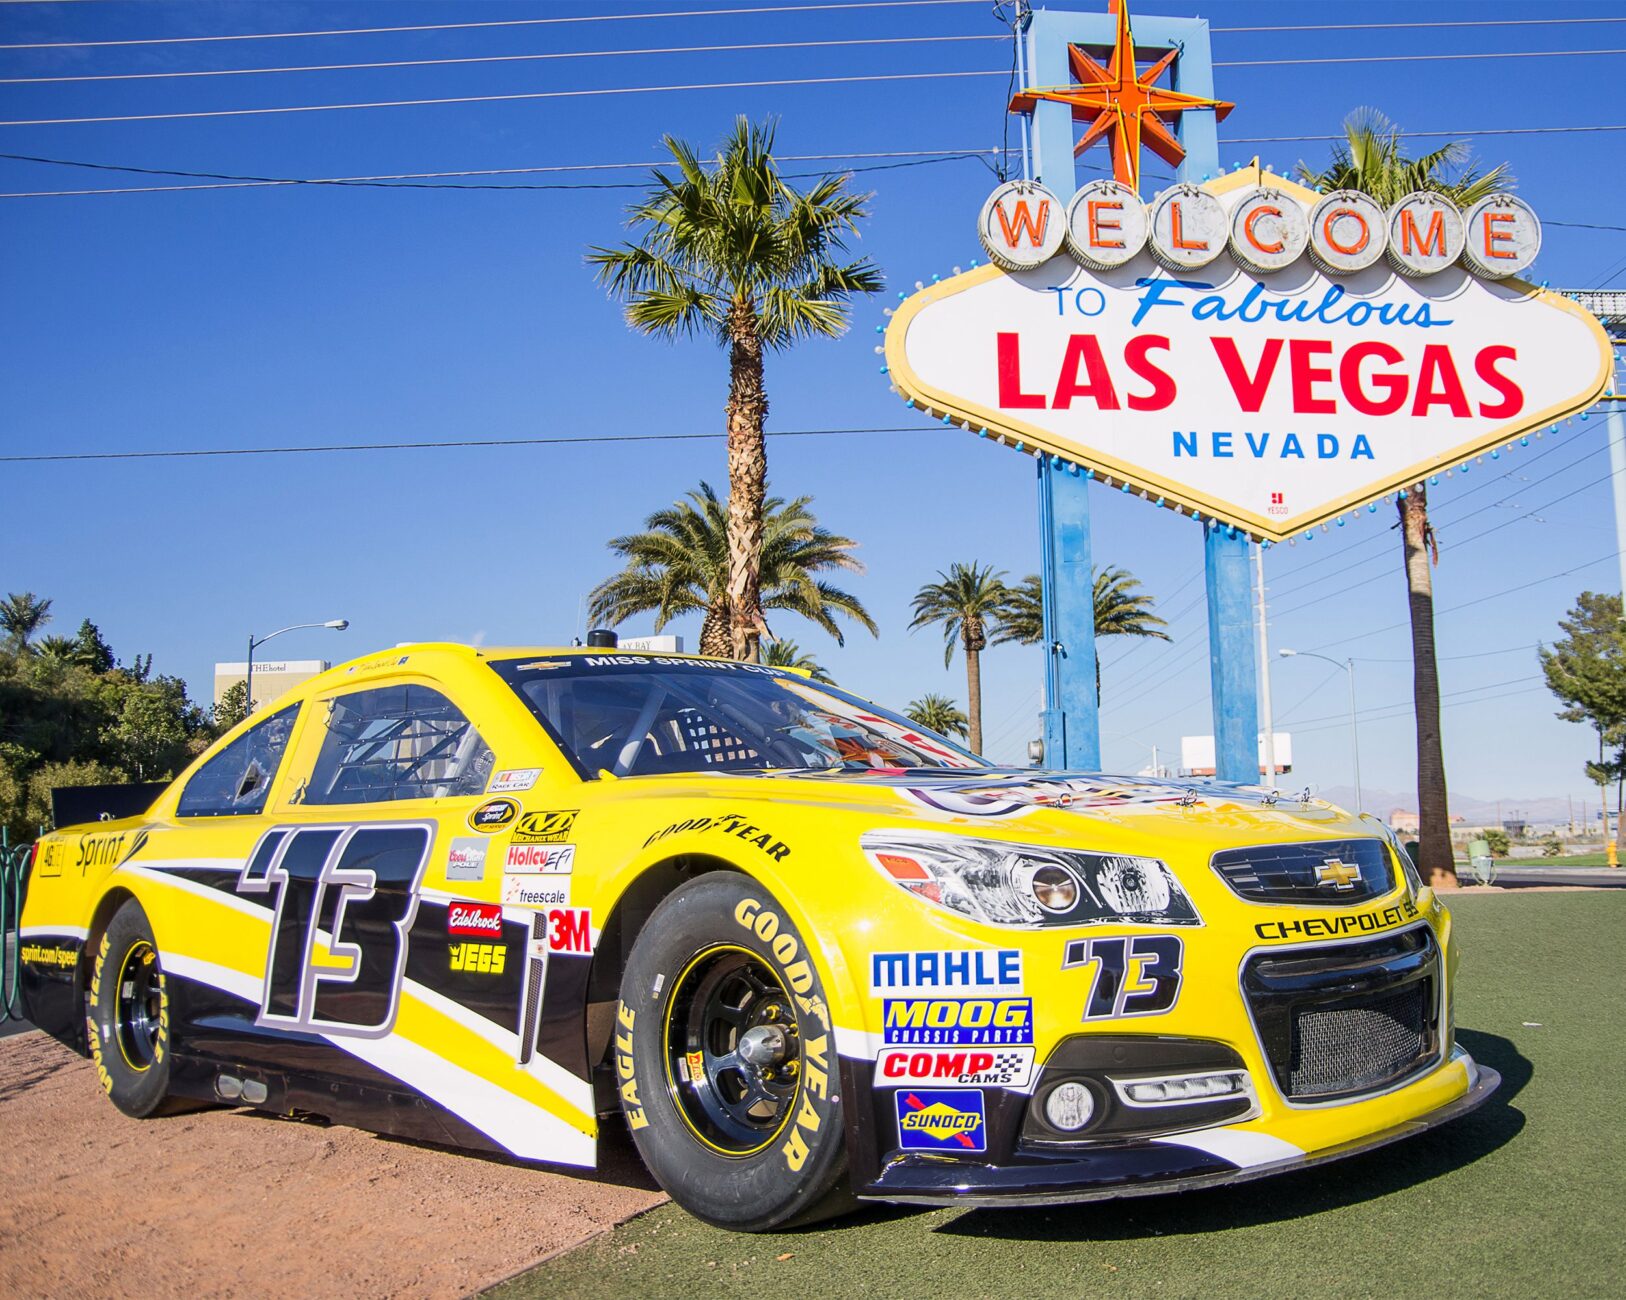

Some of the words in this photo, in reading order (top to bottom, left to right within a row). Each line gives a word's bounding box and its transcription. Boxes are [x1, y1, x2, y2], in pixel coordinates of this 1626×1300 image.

[995, 199, 1520, 259] WELCOME
[1047, 285, 1107, 318] TO
[1131, 277, 1455, 328] Fabulous
[996, 331, 1178, 412] LAS
[1209, 335, 1525, 421] VEGAS
[1172, 431, 1376, 461] NEVADA
[586, 656, 649, 667] MISS
[653, 656, 738, 671] SPRINT
[743, 664, 786, 677] CUP
[76, 832, 127, 878] Sprint
[507, 846, 549, 872] Holley
[545, 848, 573, 870] EFI
[520, 889, 566, 904] freescale
[1403, 900, 1419, 919] SS
[449, 908, 502, 931] Edelbrock
[549, 909, 592, 953] 3M
[449, 942, 507, 974] JEGS
[872, 950, 1021, 988] MAHLE
[885, 1000, 1030, 1028] MOOG
[891, 1029, 960, 1044] CHASSIS
[971, 1029, 1024, 1043] PARTS
[615, 999, 651, 1130] EAGLE
[882, 1052, 994, 1078] COMP
[957, 1073, 1013, 1084] CAMS
[905, 1114, 977, 1129] SUNOCO
